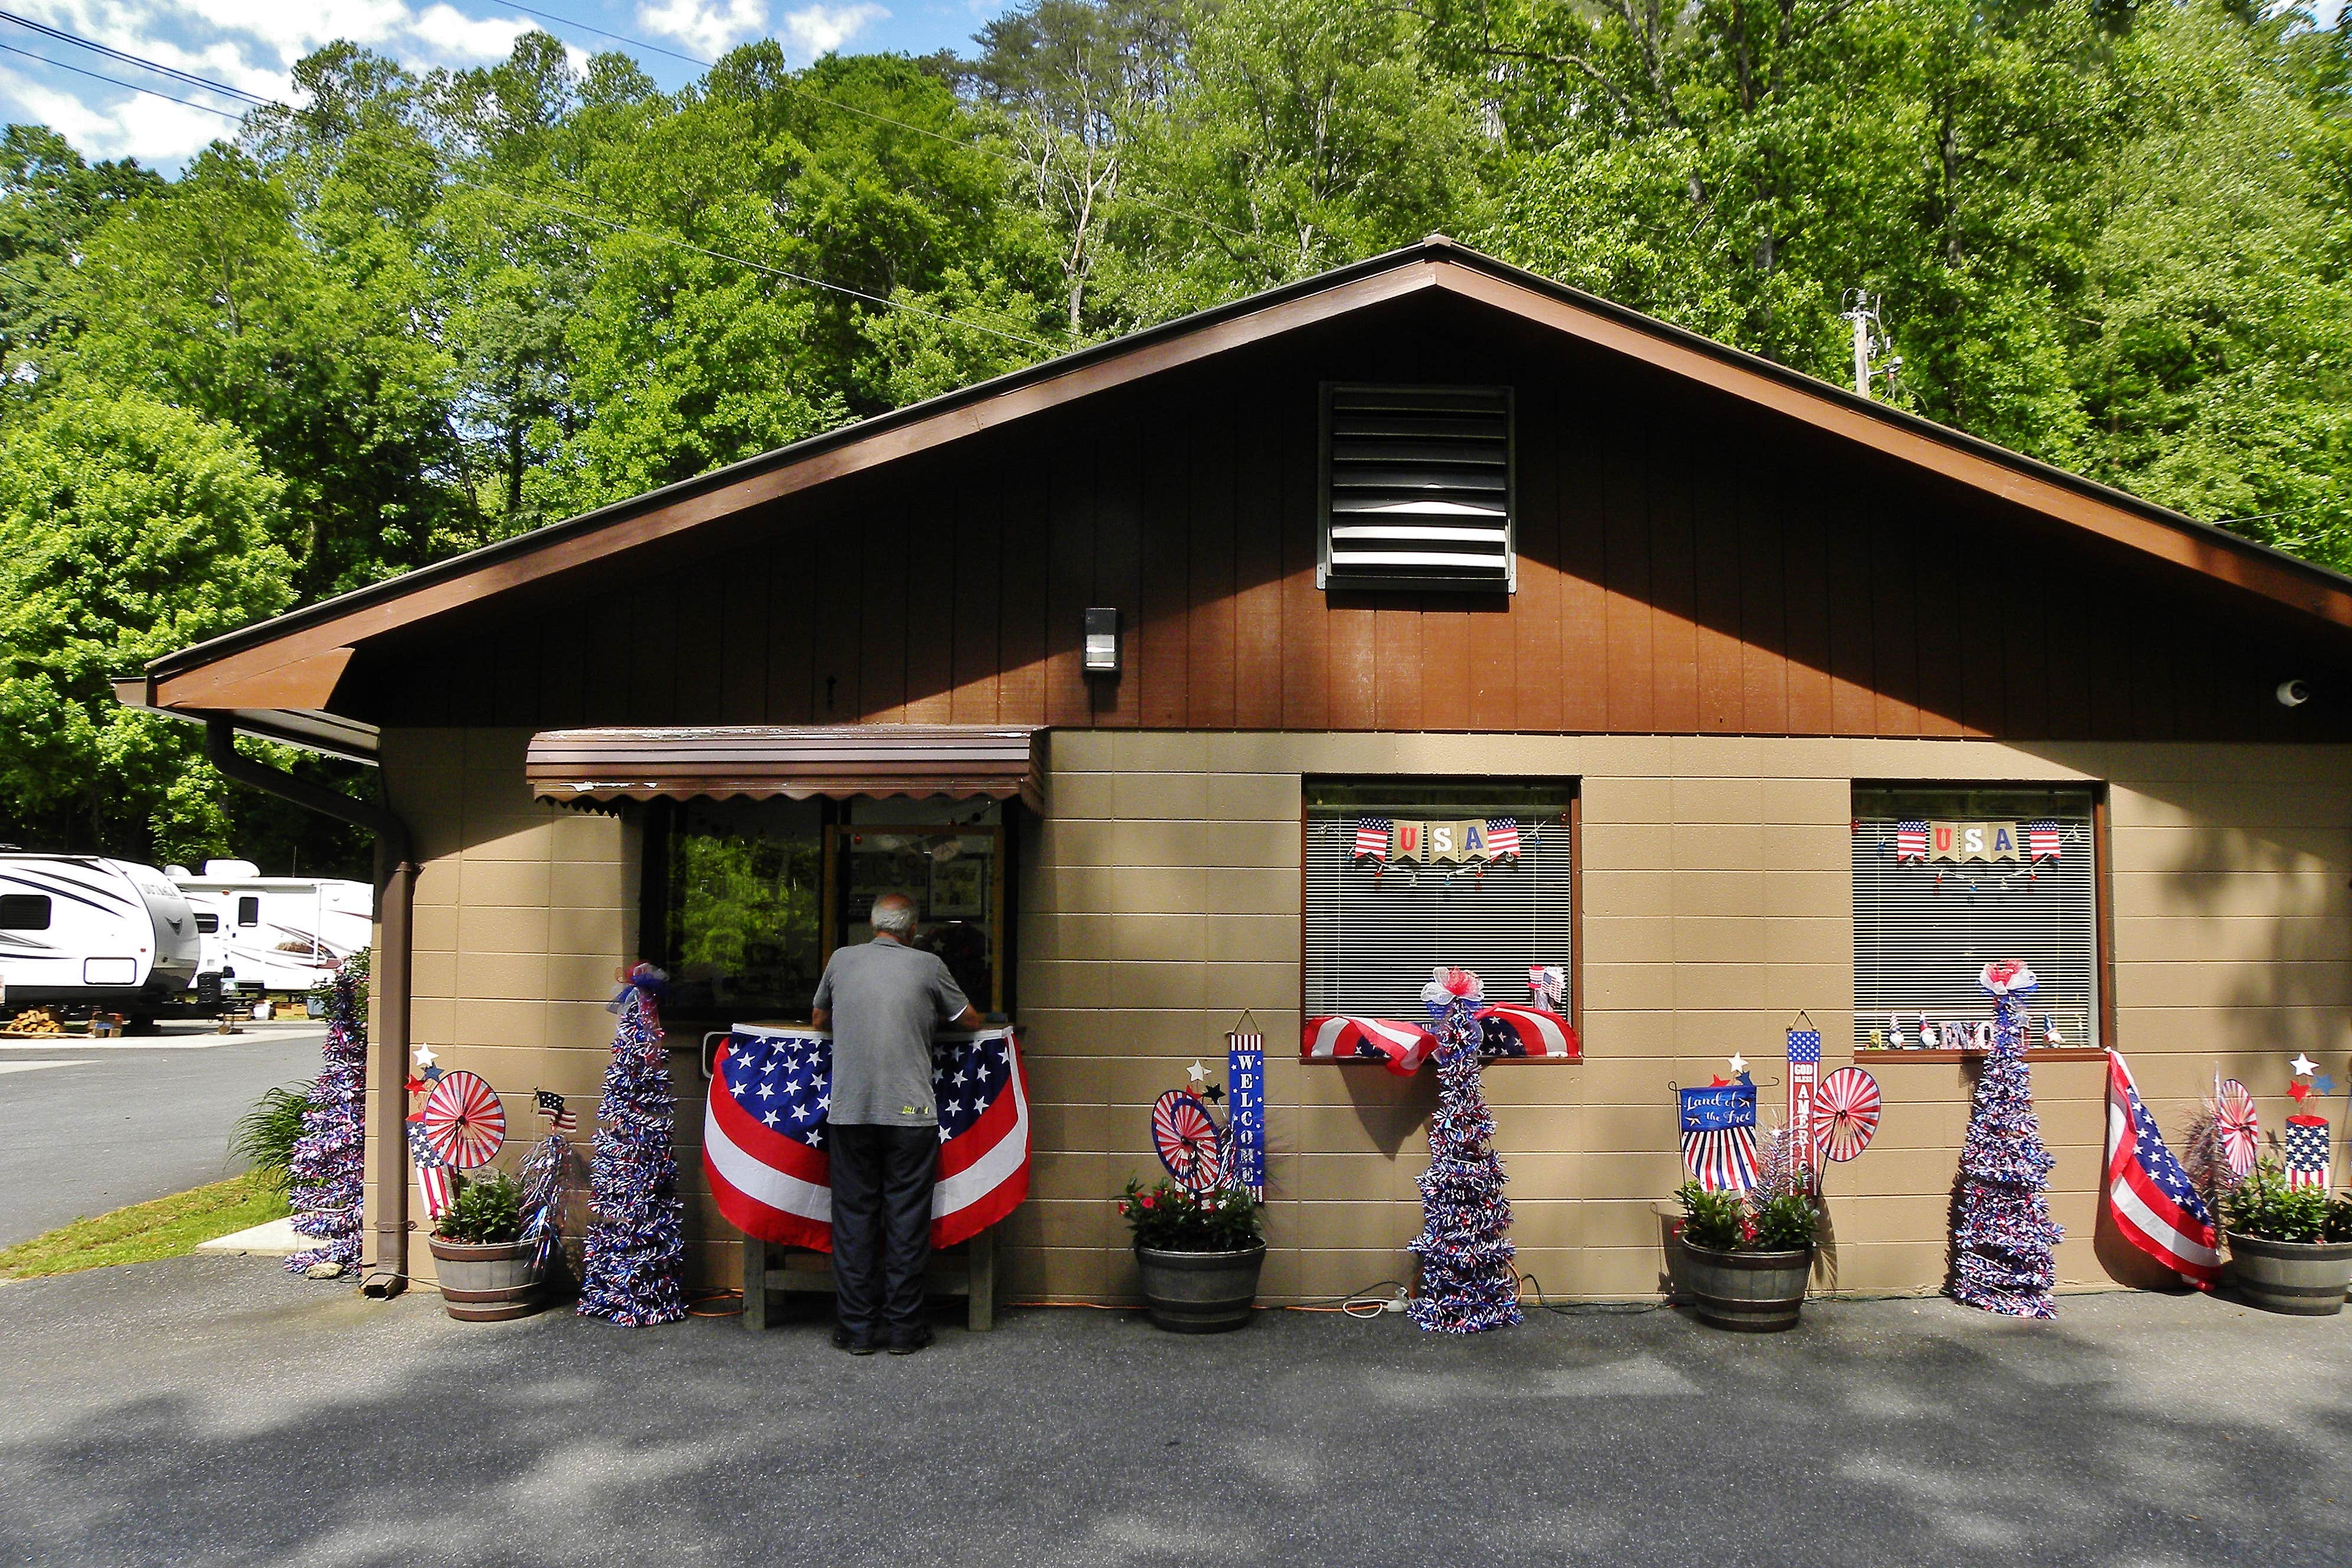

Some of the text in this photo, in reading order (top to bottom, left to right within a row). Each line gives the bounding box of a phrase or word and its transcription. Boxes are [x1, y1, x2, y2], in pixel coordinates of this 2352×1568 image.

[1400, 827, 1484, 852] USA
[1935, 828, 2013, 852] USA
[1794, 1064, 1813, 1075] GOD
[1687, 1091, 1737, 1111] Land of
[1237, 1055, 1256, 1182] WELCOME
[1706, 1110, 1751, 1123] the Free
